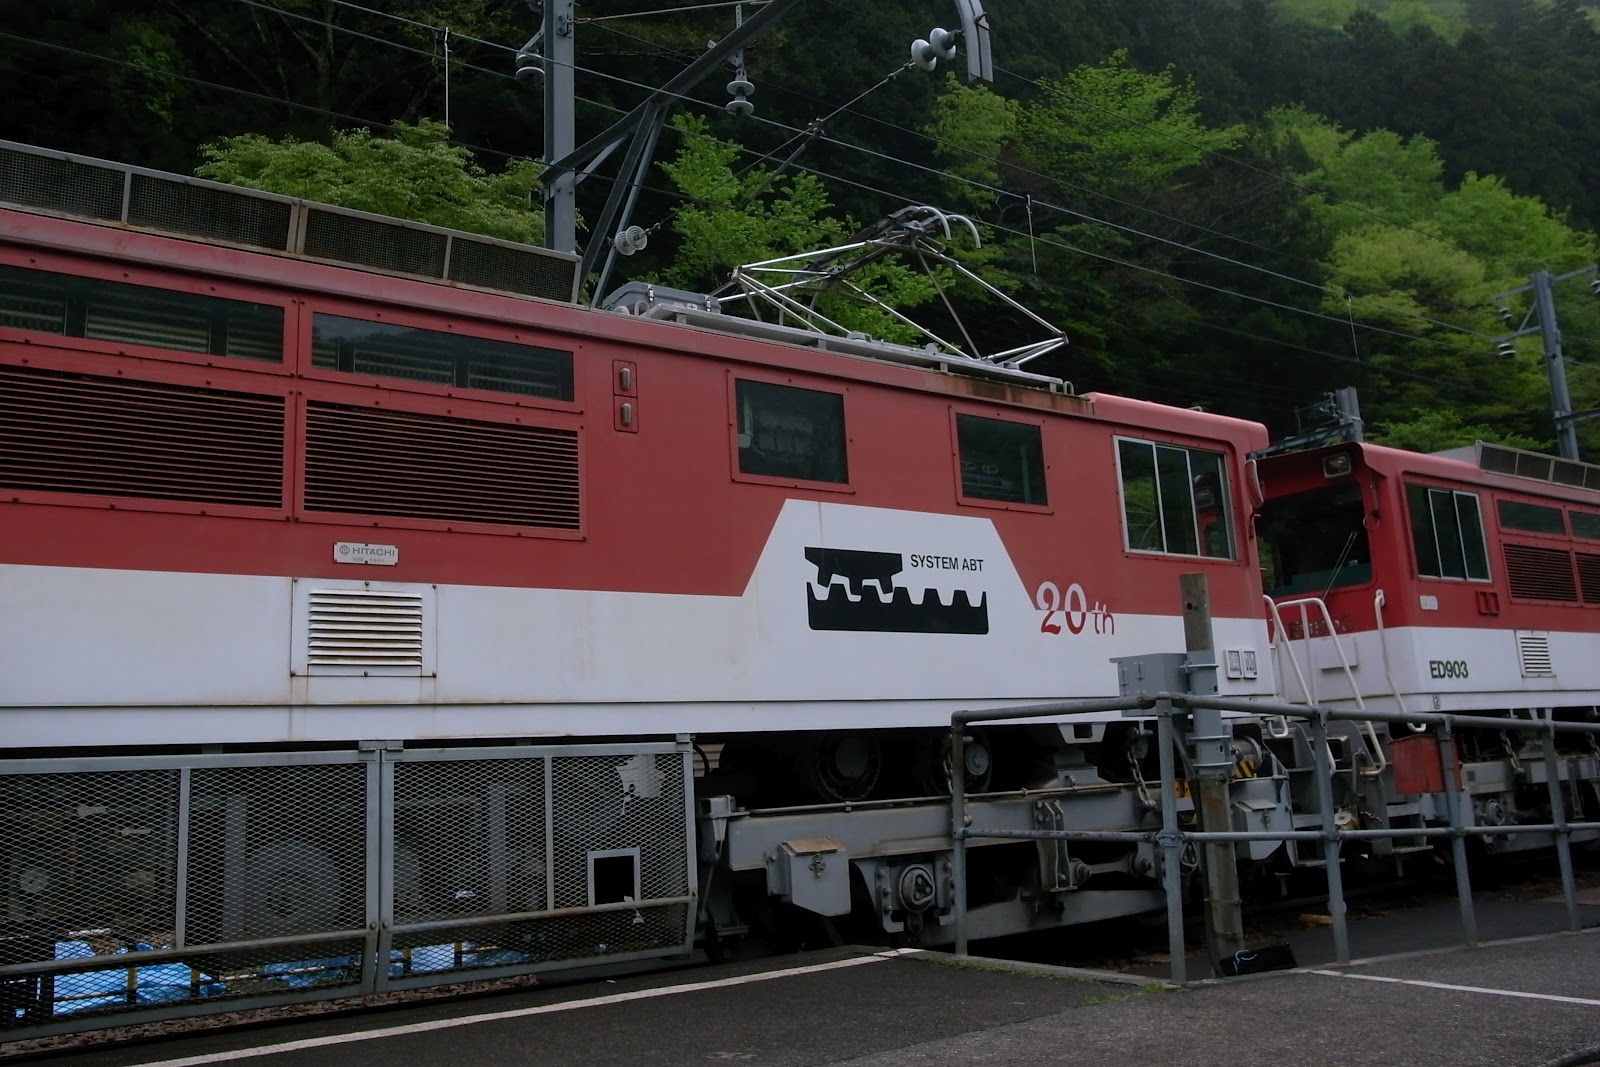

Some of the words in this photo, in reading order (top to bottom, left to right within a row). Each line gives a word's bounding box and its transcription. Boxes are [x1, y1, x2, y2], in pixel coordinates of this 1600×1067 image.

[352, 547, 395, 556] HITACHI
[910, 554, 959, 570] SYSTEM
[962, 558, 984, 571] ABT
[1036, 581, 1115, 635] 20th
[1429, 660, 1469, 679] ED903
